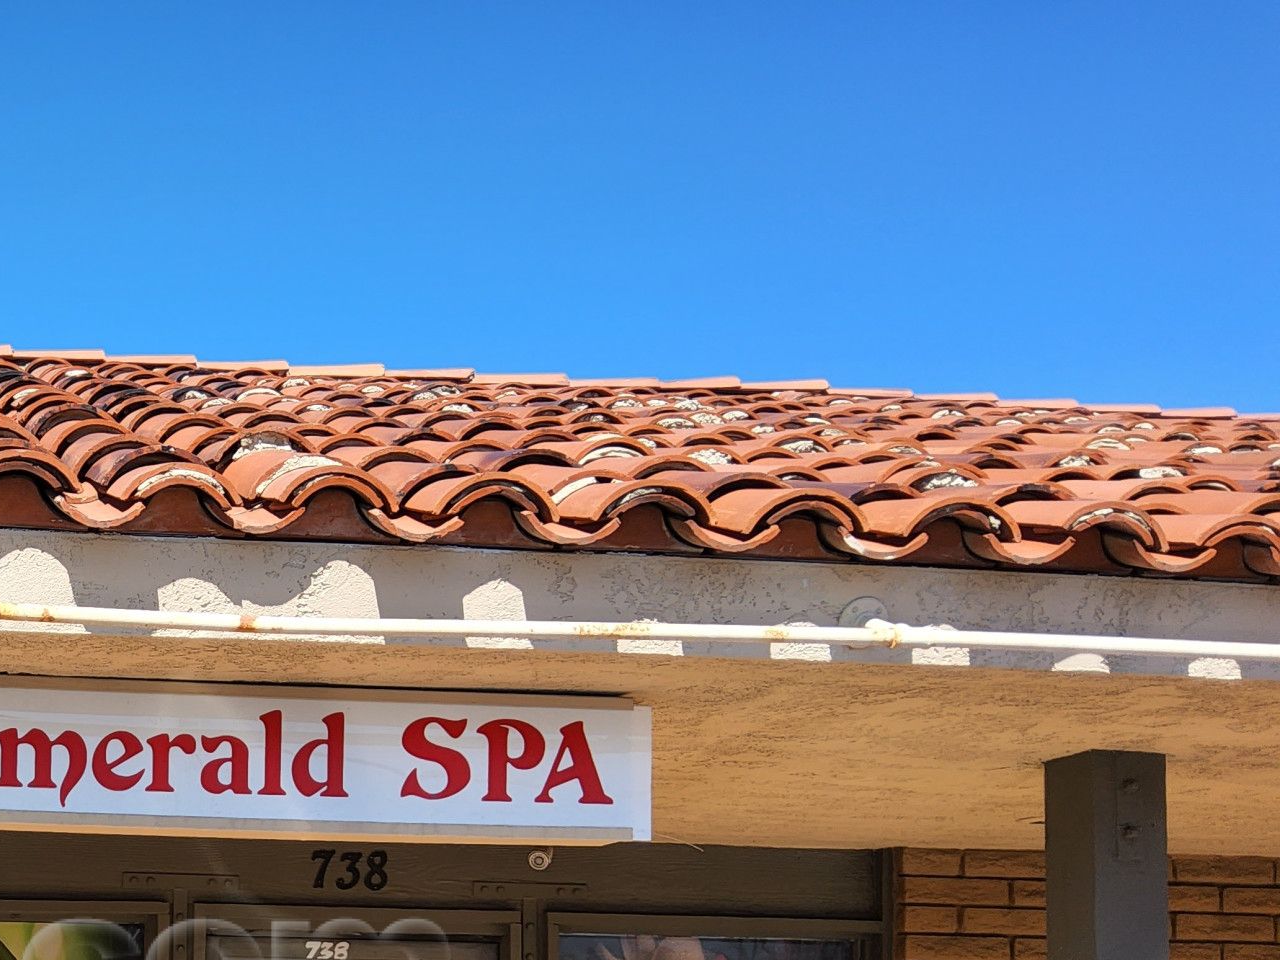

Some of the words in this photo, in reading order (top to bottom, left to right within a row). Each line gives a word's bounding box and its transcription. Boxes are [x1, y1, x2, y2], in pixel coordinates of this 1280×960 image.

[400, 716, 613, 804] SPA
[311, 849, 388, 891] 738
[305, 941, 350, 960] 738
